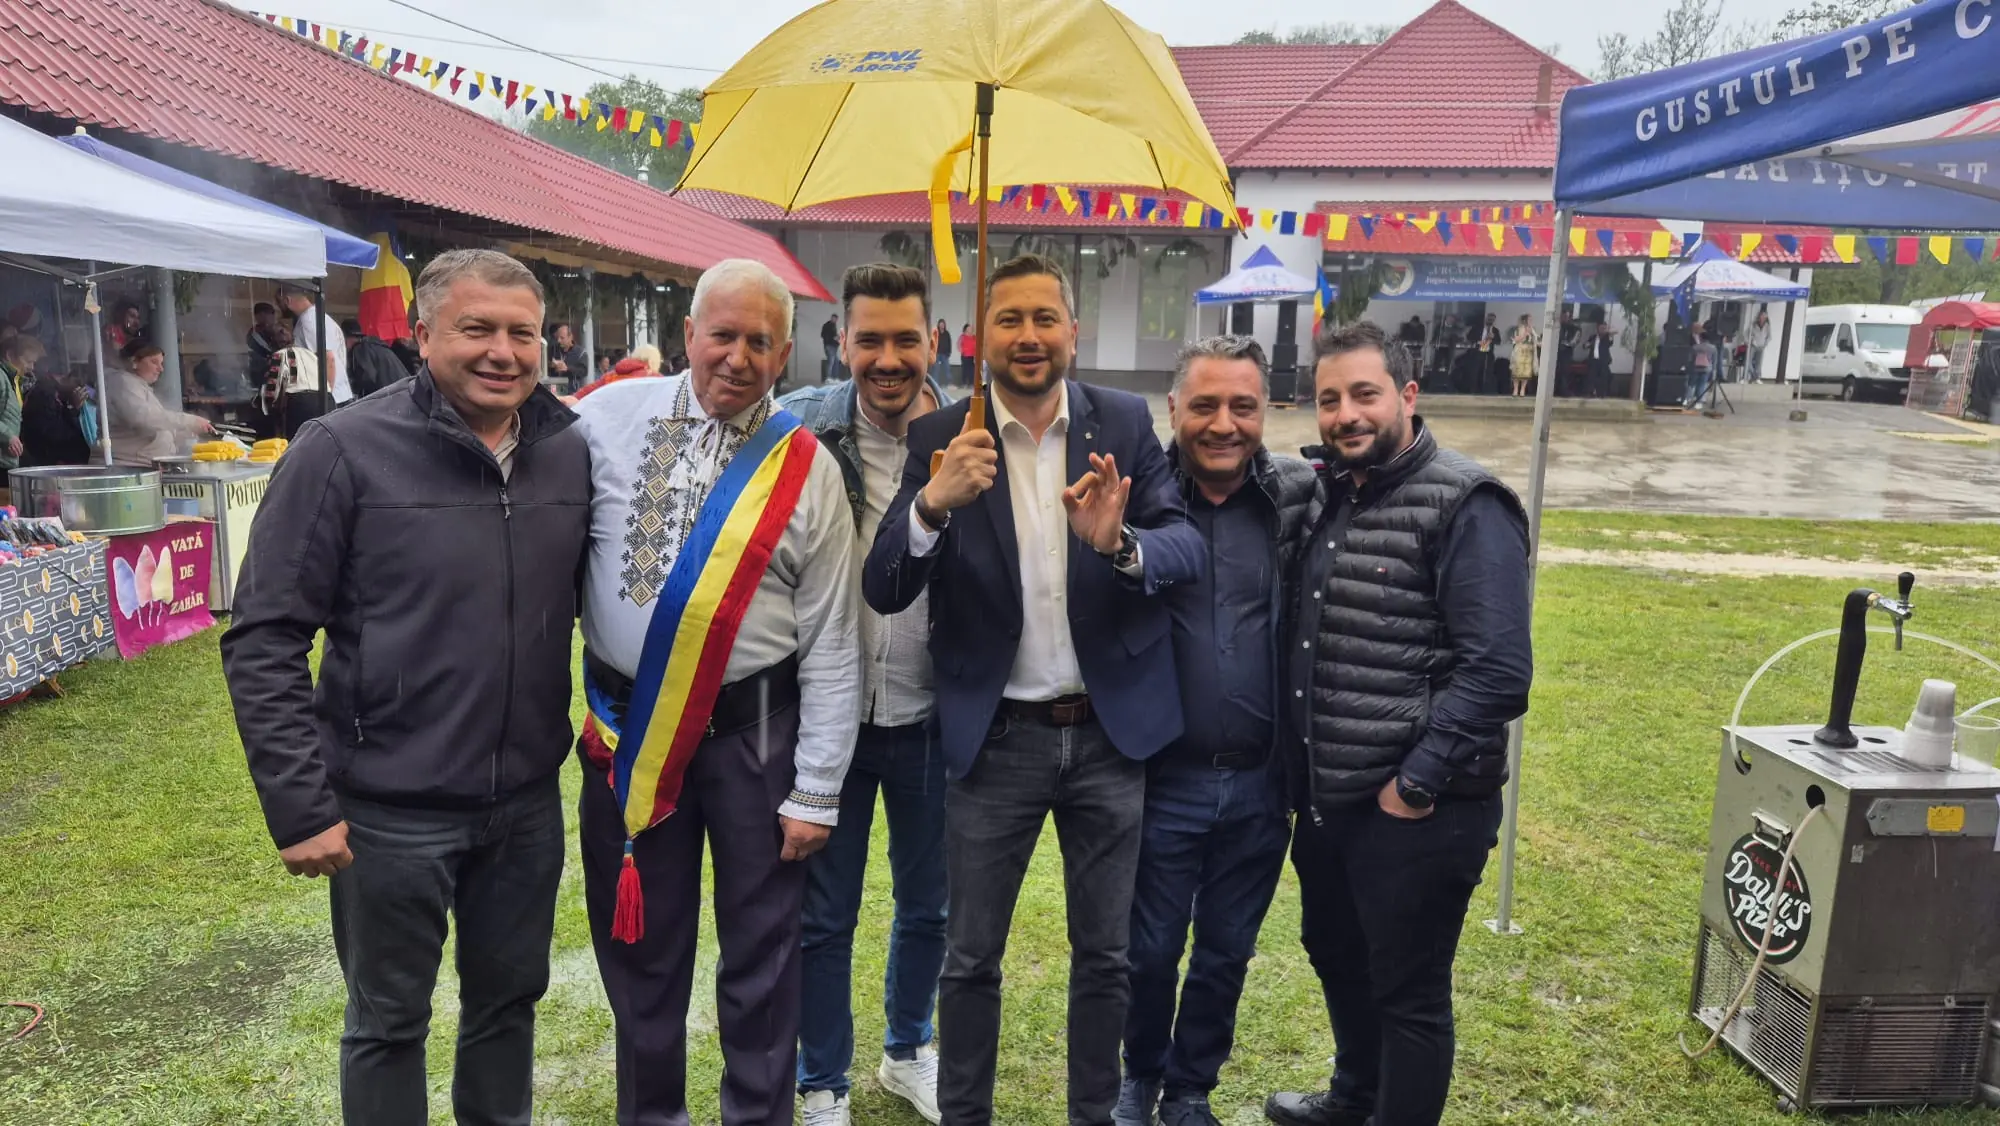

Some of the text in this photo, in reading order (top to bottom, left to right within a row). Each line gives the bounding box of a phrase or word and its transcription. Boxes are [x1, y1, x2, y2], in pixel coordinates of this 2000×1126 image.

[859, 48, 922, 63] PNL
[1635, 57, 1815, 141] GUSTUL
[1841, 18, 1915, 79] PE
[171, 531, 204, 553] VATĂ
[180, 564, 195, 580] DE
[169, 590, 205, 616] ZAHĂR
[1750, 851, 1800, 892] TAKE AAY
